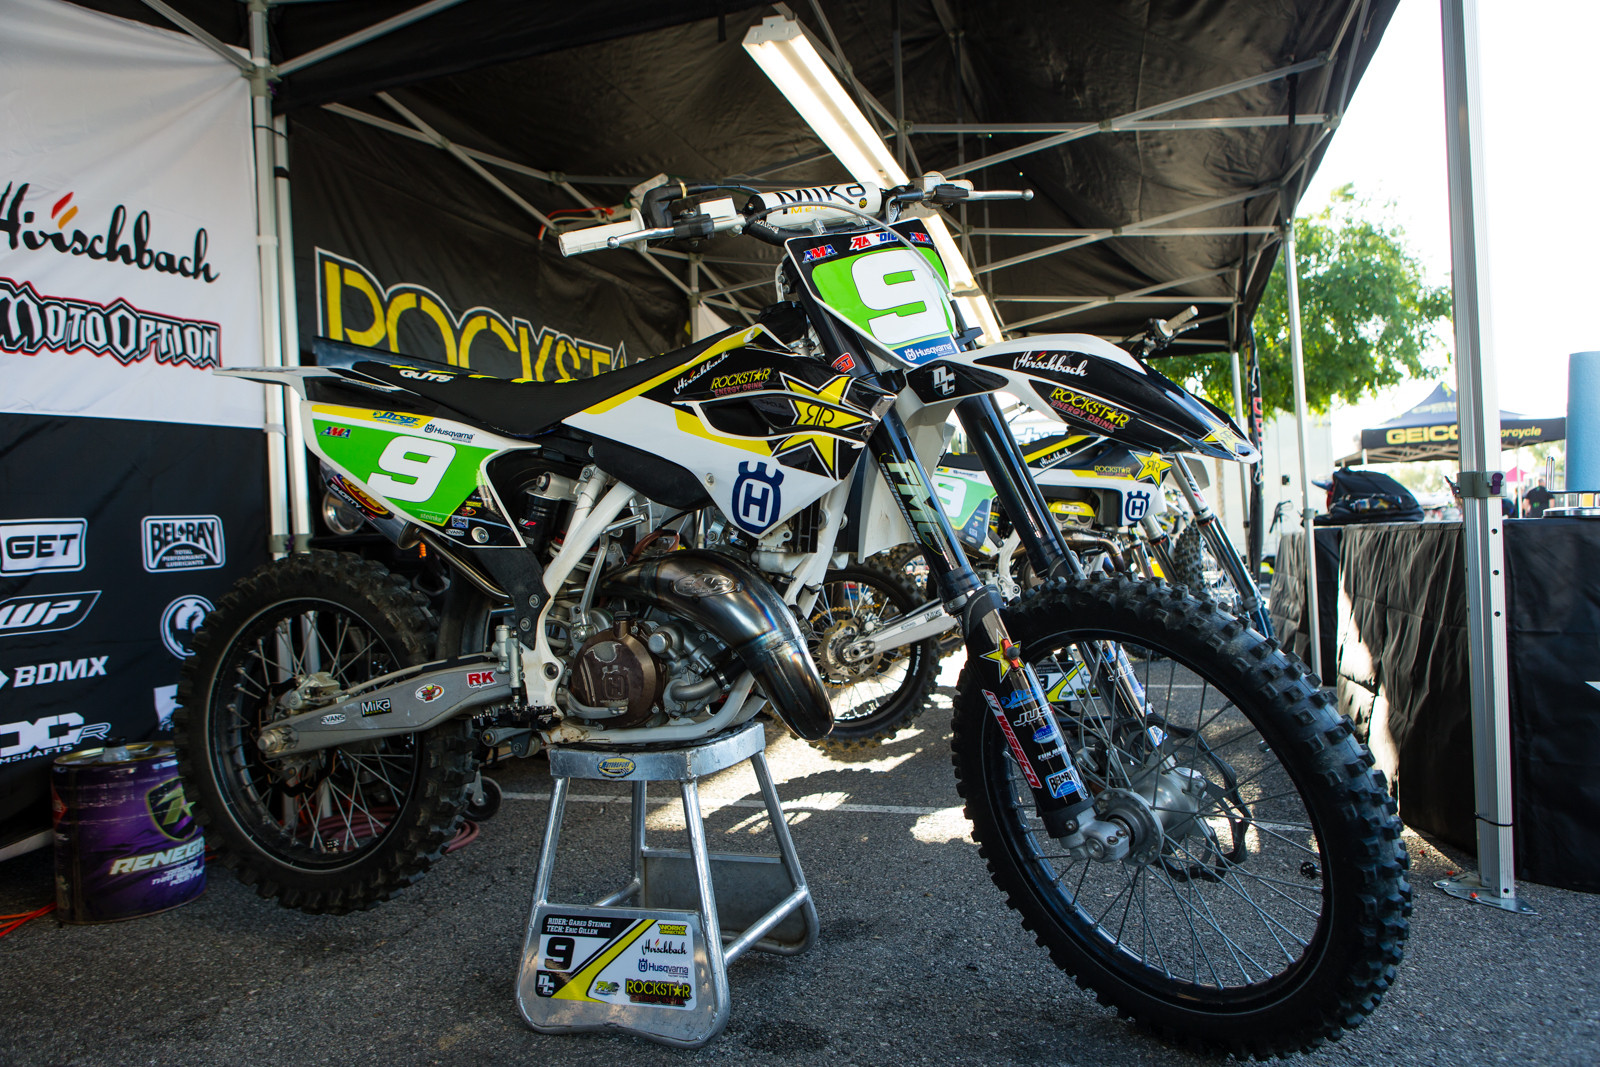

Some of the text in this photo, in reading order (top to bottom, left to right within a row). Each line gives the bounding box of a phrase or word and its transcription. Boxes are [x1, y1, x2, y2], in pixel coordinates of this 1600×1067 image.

[0, 181, 220, 283] Hirschbach
[803, 245, 838, 262] AMA
[852, 250, 952, 345] 9
[915, 343, 954, 358] Husqvarna
[1012, 351, 1088, 377] Hirschbach
[400, 369, 455, 383] GUTS
[1051, 399, 1117, 431] ENERGY DRINK
[434, 427, 473, 440] Husqvarna
[366, 435, 457, 503] 9
[6, 534, 79, 560] GET
[13, 656, 109, 688] BDMX
[468, 671, 495, 684] RK
[546, 925, 565, 933] TECH:
[547, 917, 568, 926] RIDER:
[544, 936, 575, 970] 9
[648, 963, 688, 976] Husqvarna
